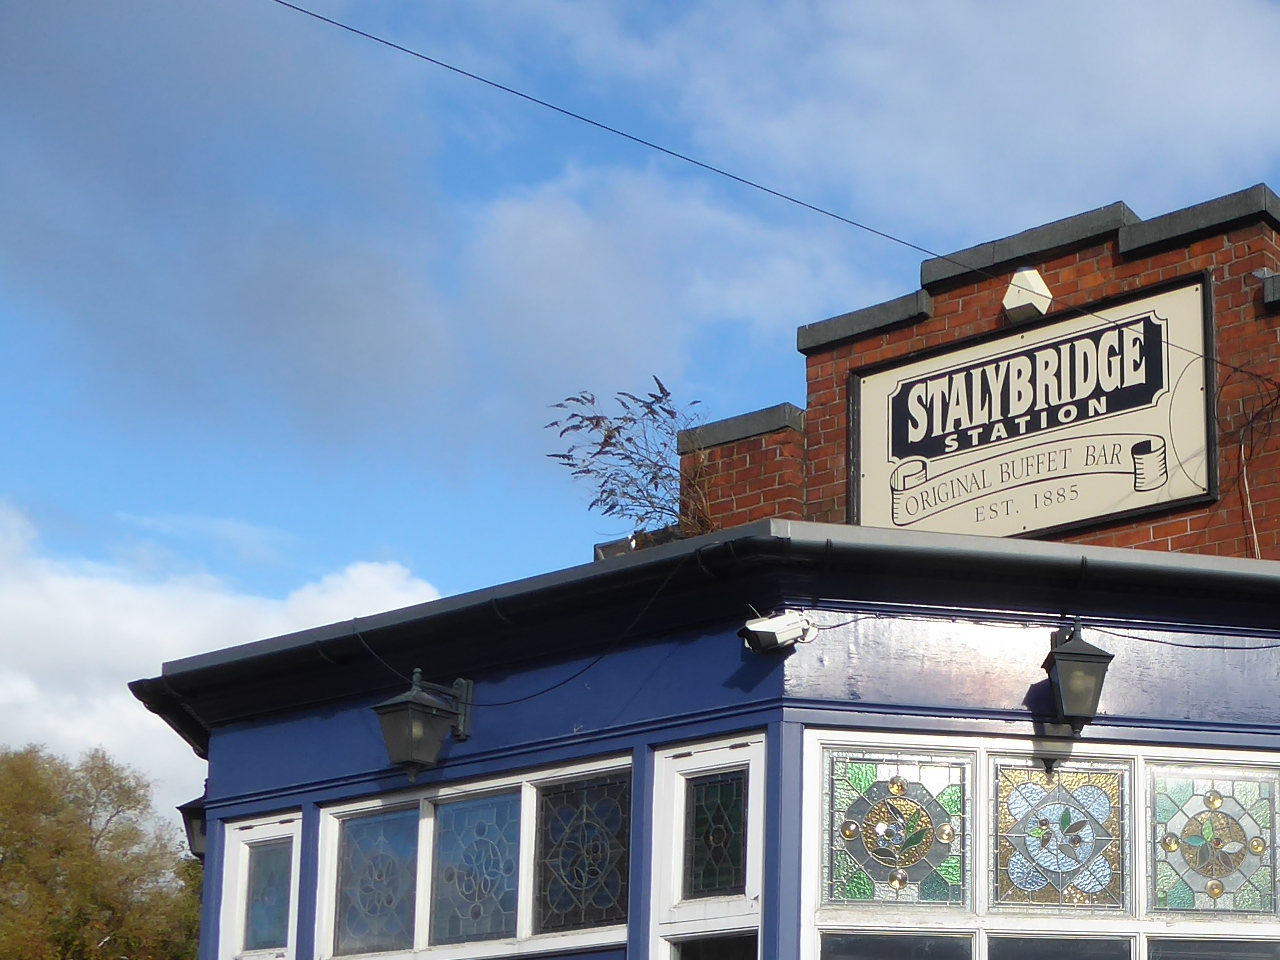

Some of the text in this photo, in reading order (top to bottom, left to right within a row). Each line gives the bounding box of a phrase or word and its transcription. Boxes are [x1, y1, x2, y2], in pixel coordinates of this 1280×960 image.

[906, 320, 1147, 444] STALYBRIDGE
[943, 395, 1108, 454] STATION
[904, 442, 1122, 517] ORIGINAL BUFFET BAR
[974, 483, 1080, 523] EST. 1885
